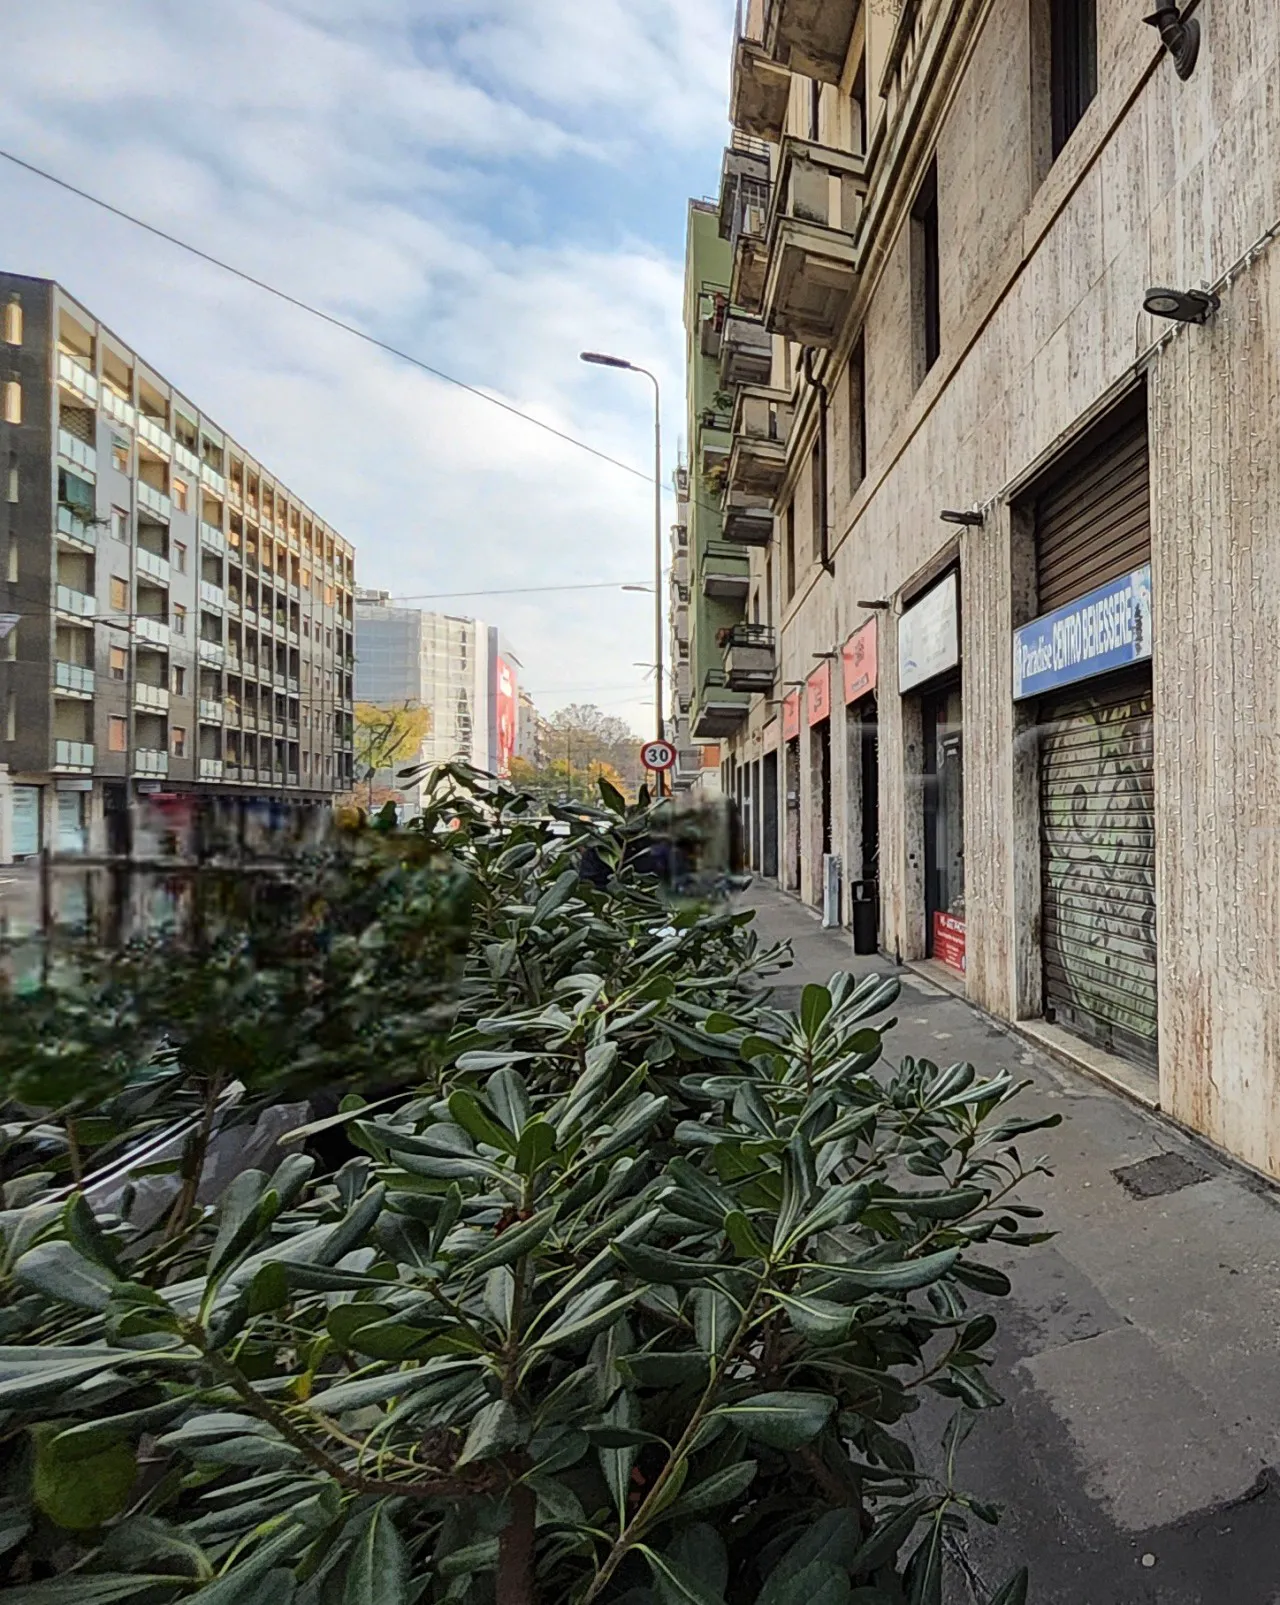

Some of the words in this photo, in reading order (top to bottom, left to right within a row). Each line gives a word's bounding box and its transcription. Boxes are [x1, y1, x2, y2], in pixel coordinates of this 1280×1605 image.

[1021, 635, 1052, 679] Paradise
[1053, 611, 1081, 672] CENTRO
[1082, 586, 1133, 660] BENESSERE
[648, 748, 669, 763] 30
